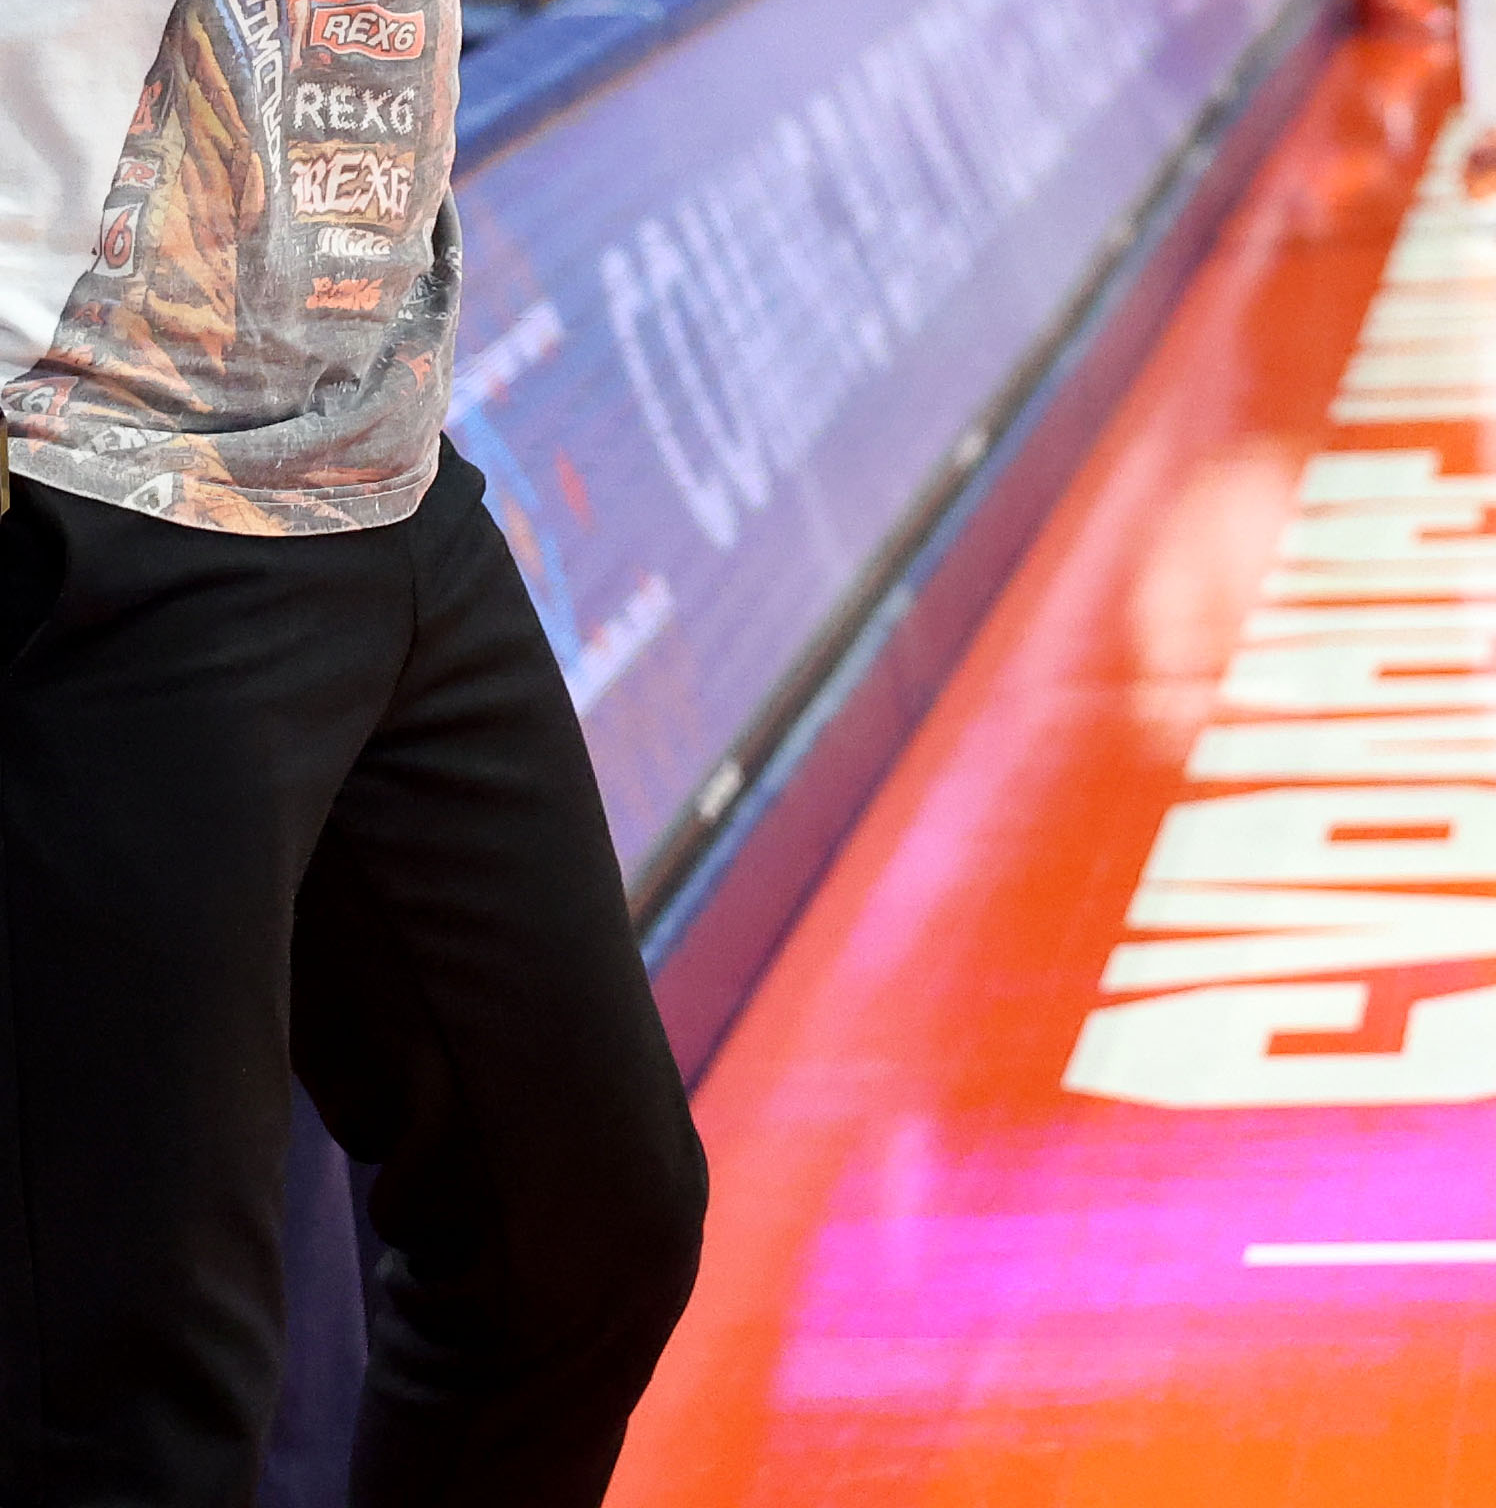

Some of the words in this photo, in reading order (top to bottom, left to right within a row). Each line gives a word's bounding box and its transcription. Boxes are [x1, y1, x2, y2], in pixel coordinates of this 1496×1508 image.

[322, 11, 417, 52] REX6
[292, 81, 416, 135] REX6
[290, 150, 412, 220] REX6
